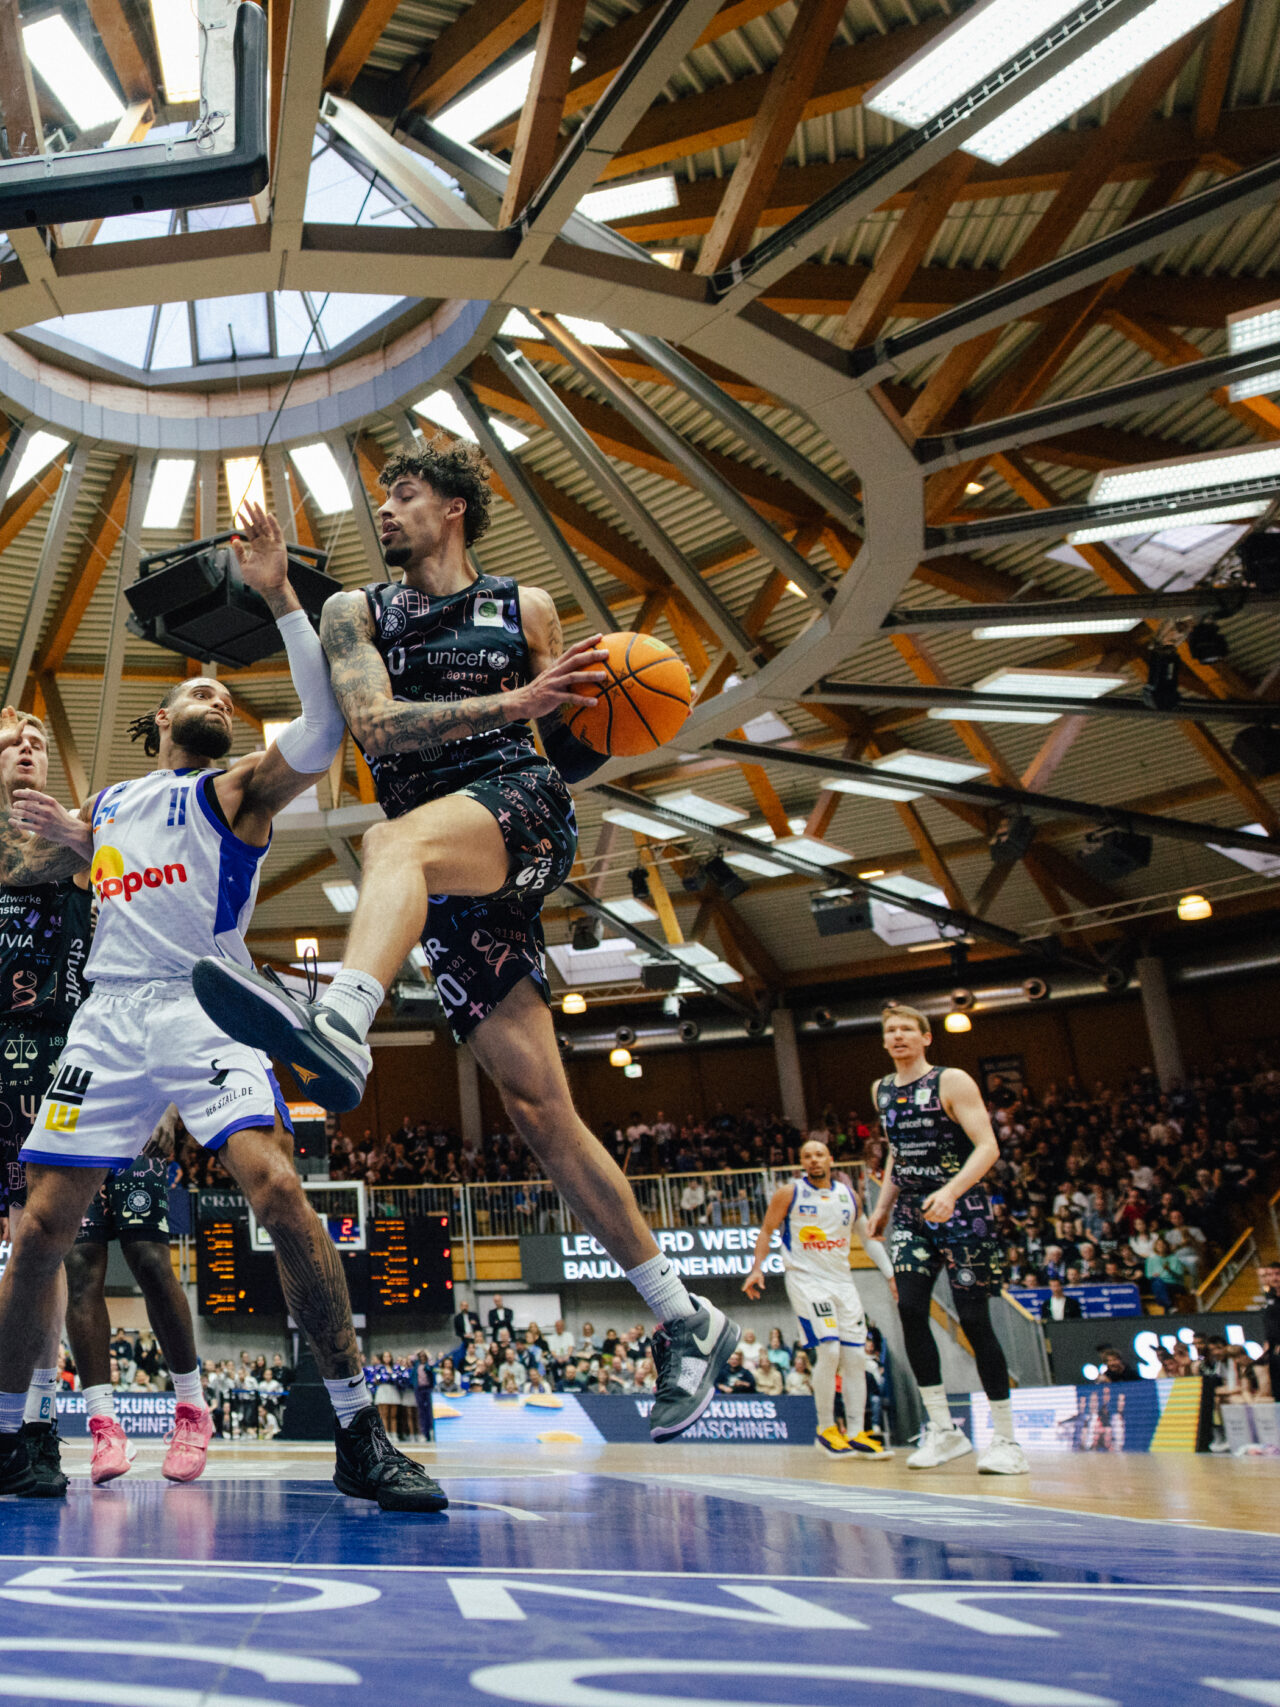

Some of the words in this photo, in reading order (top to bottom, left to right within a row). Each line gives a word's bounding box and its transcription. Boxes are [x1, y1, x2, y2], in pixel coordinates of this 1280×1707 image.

[427, 648, 486, 667] unicef
[424, 692, 472, 703] Stadtw
[167, 787, 190, 826] 11
[96, 863, 187, 902] ppon
[698, 1226, 783, 1252] WEISS
[55, 1397, 177, 1415] VERCKUNGS
[681, 1420, 789, 1440] MASCHINEN
